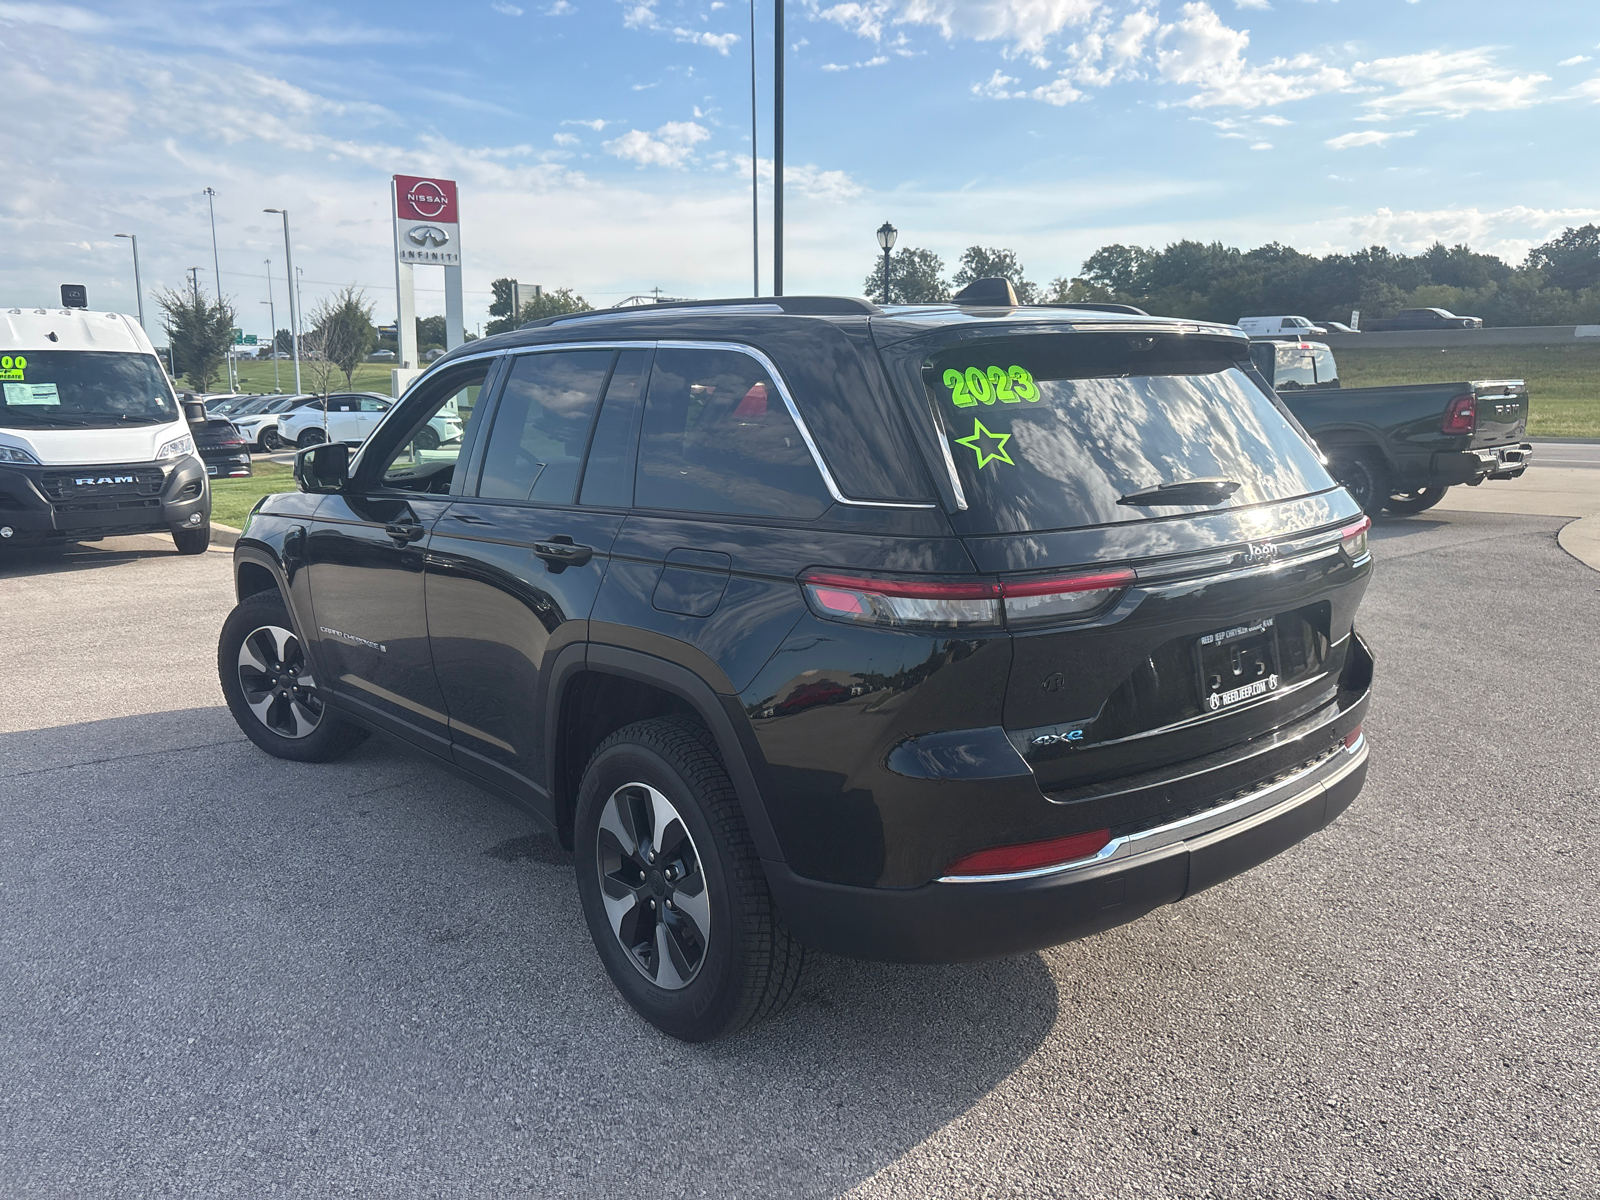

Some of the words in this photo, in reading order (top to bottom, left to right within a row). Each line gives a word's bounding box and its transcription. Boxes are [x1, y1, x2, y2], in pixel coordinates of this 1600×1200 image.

[407, 194, 448, 204] NISSAN
[401, 250, 458, 261] INFINITI
[1, 355, 27, 369] 00
[942, 364, 1041, 409] 2023
[1494, 404, 1520, 415] RAM
[75, 476, 133, 486] RAM
[1244, 543, 1278, 564] Jeep
[1200, 634, 1214, 645] REED
[1214, 631, 1226, 641] JEEP
[1226, 626, 1249, 639] CHRYSLER
[1262, 618, 1274, 628] RAM
[1222, 681, 1267, 706] REEDJEEP.COM
